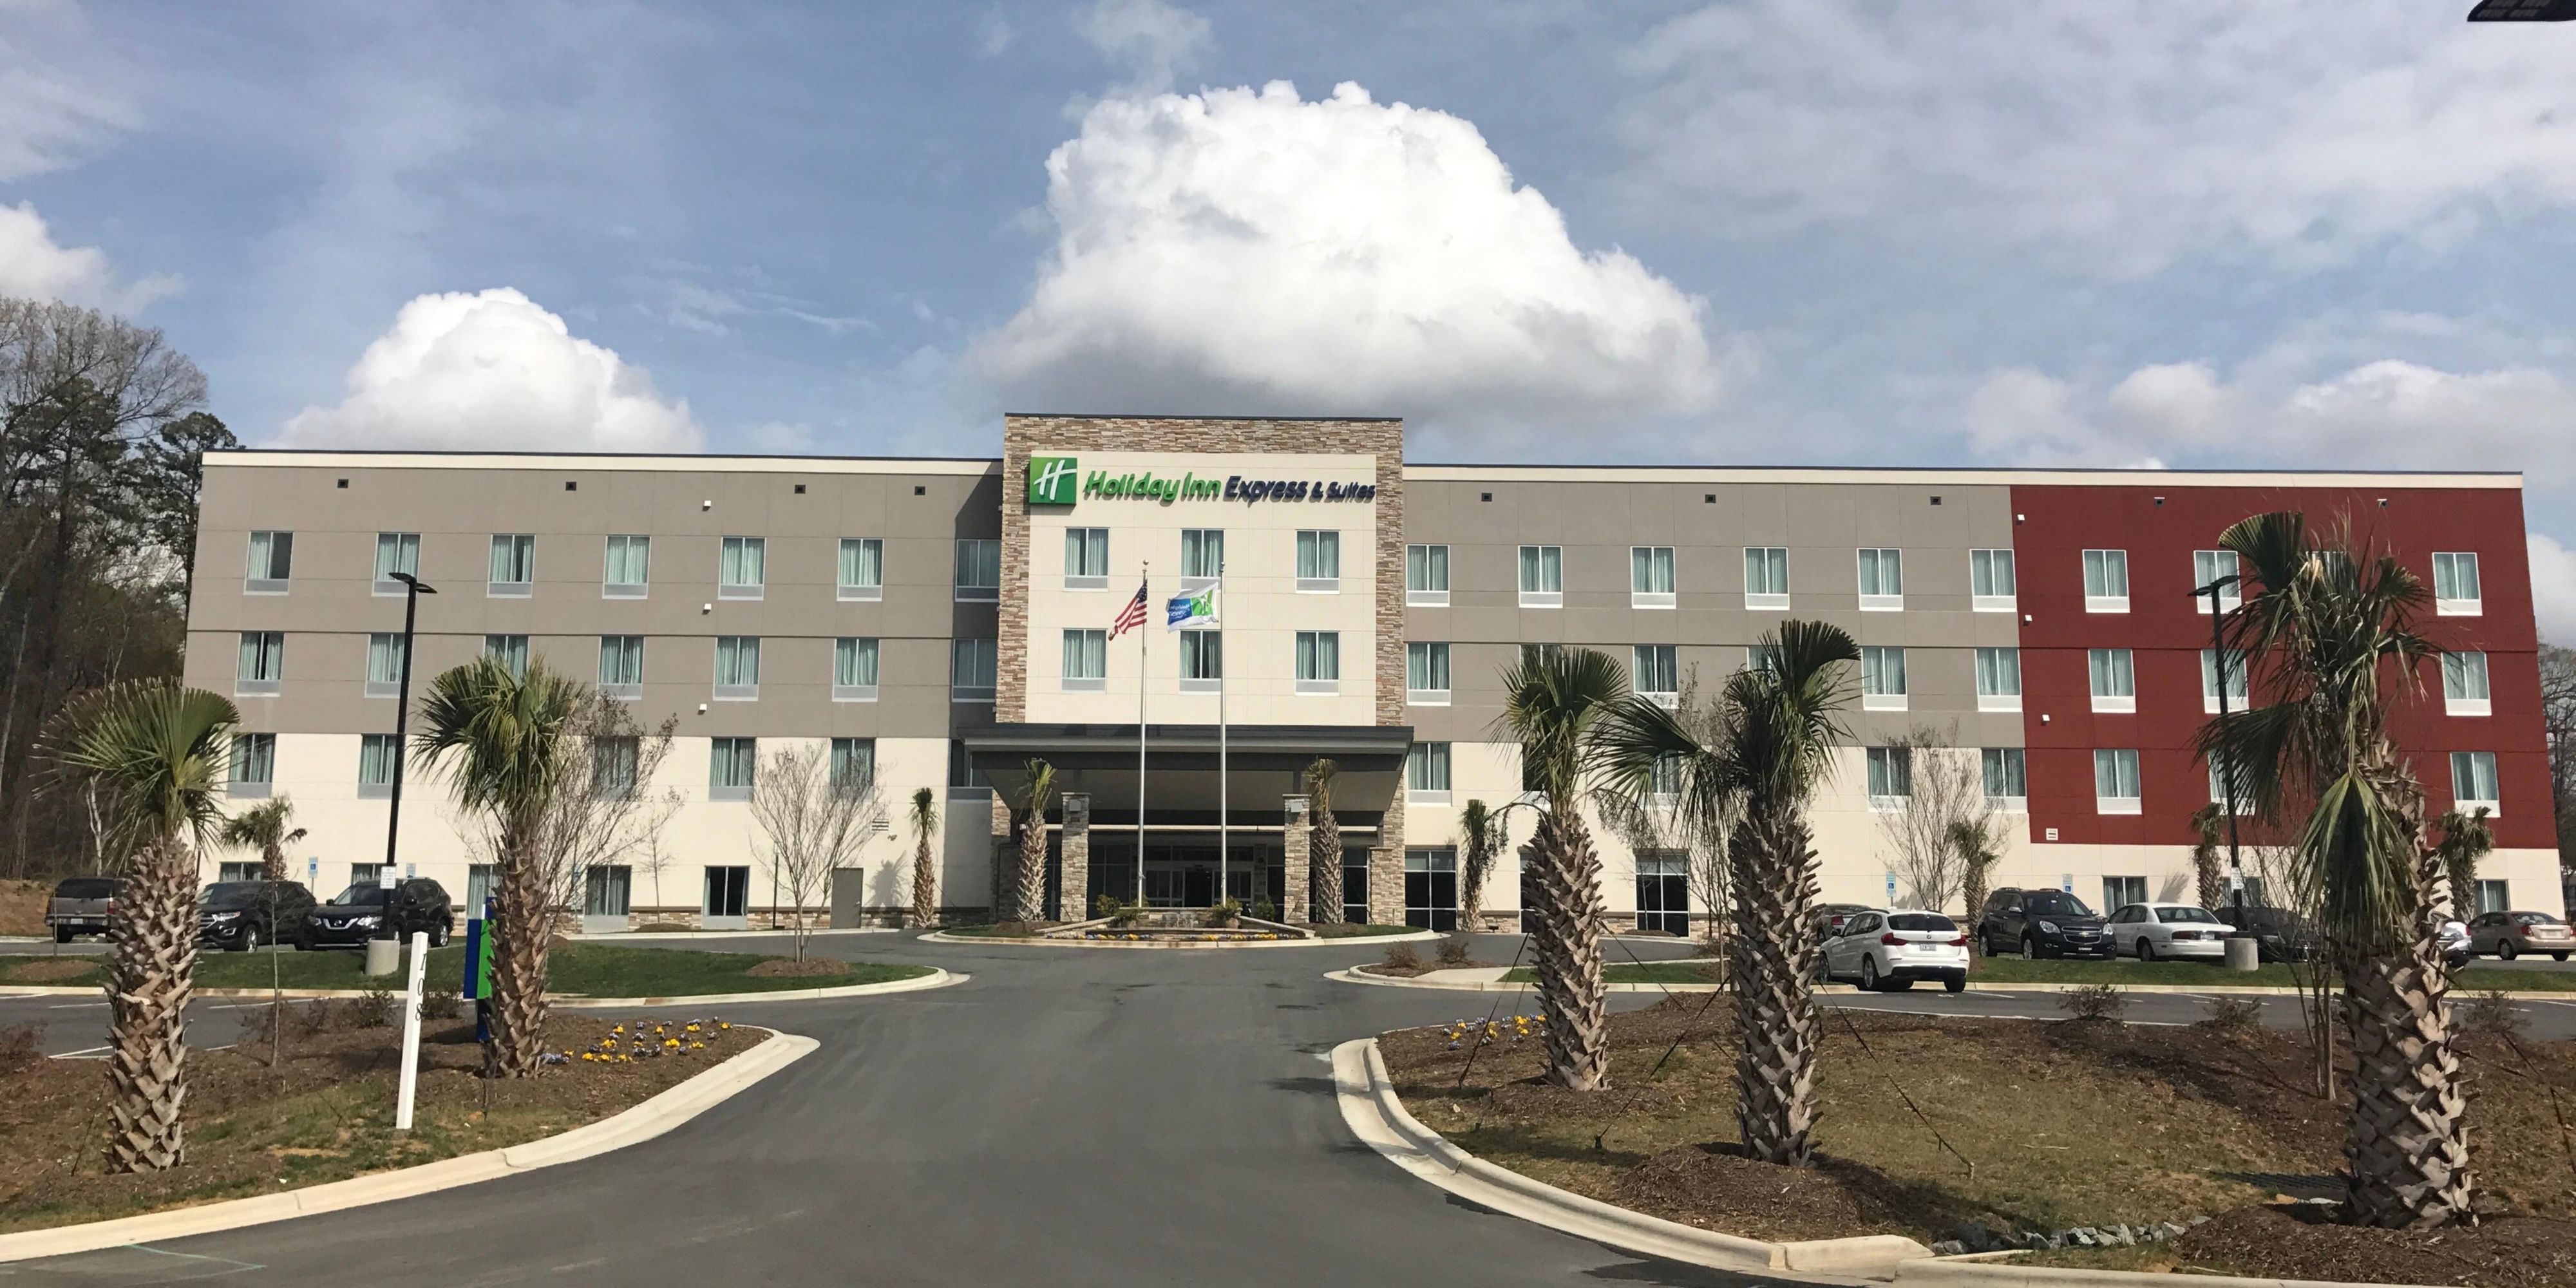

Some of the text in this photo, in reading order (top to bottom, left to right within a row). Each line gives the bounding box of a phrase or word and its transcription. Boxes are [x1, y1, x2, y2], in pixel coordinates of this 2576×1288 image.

[1084, 470, 1376, 502] Holiday Inn Express & Suites
[415, 953, 427, 1021] 108
